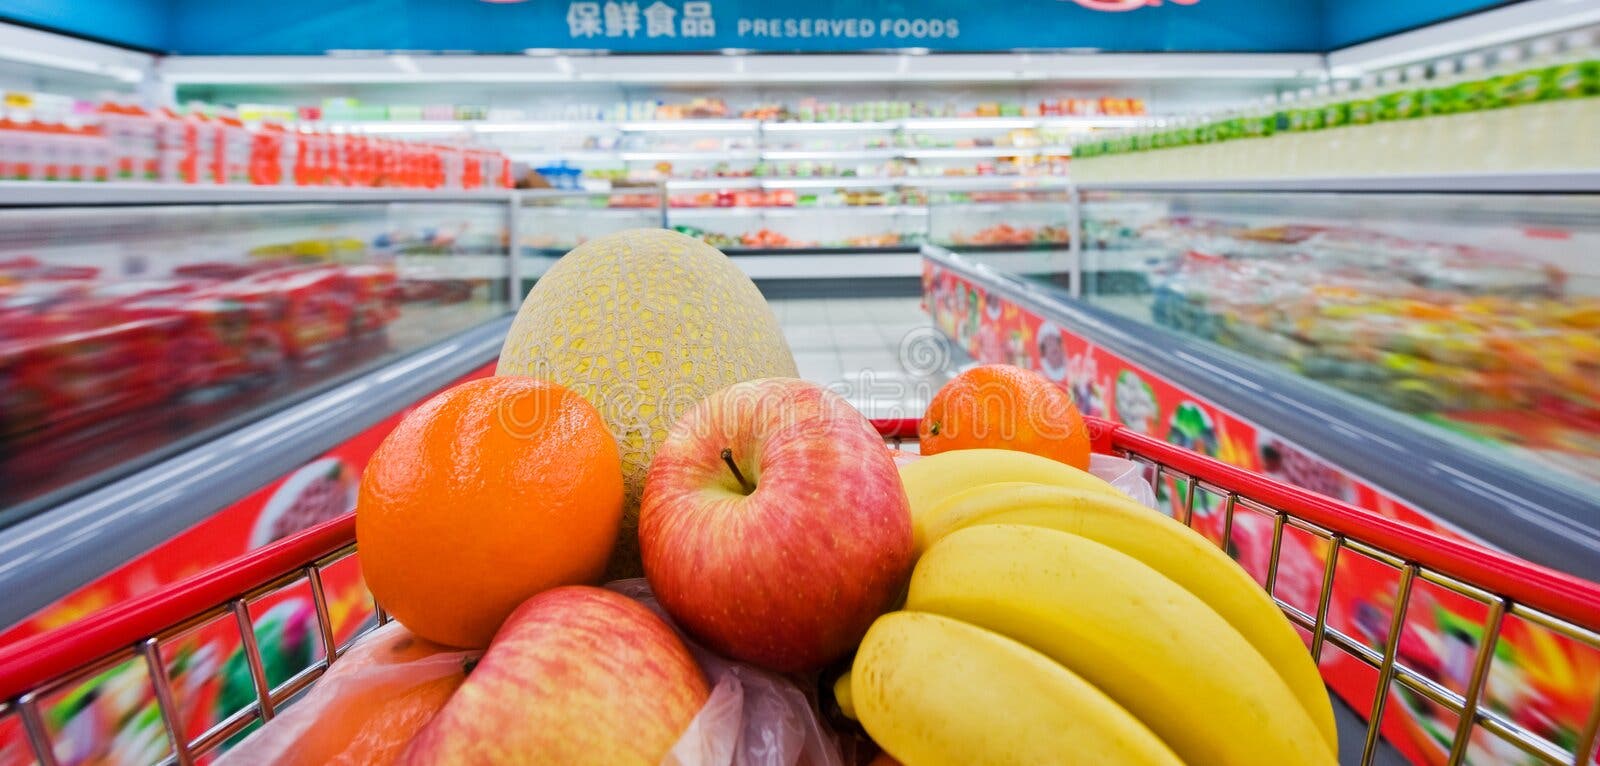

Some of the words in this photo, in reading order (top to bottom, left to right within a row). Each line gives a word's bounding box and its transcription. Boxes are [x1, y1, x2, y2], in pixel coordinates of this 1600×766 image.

[567, 1, 716, 38] 保鲜食品
[737, 18, 876, 38] PRESERVED
[880, 18, 960, 38] FOODS
